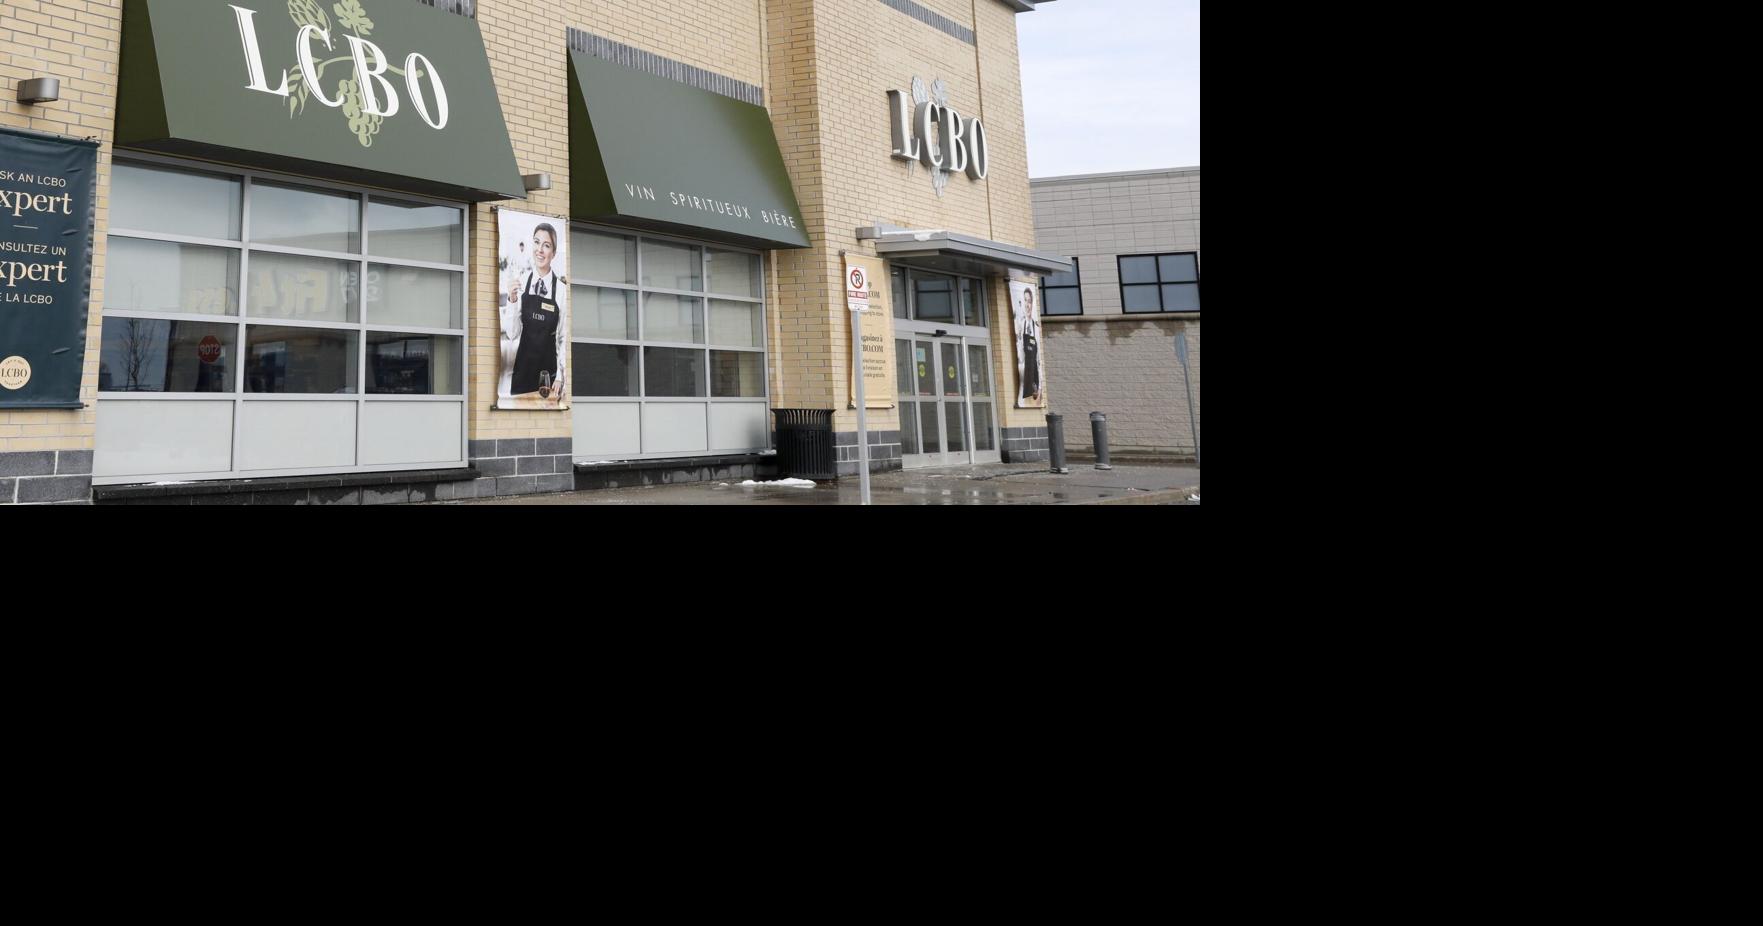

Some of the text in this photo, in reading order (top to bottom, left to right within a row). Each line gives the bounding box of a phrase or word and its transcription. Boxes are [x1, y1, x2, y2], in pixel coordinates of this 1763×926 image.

[228, 4, 449, 130] LCBO
[886, 89, 988, 181] LCBO
[0, 170, 67, 188] SK AN LCBO
[0, 189, 73, 217] xpert
[625, 183, 797, 229] VIN SPIRITUEUX BIÈRE
[0, 241, 67, 256] NSULTEZ UN
[0, 260, 67, 287] xpert
[6, 292, 20, 303] LA
[23, 294, 53, 305] LCBO
[1, 367, 28, 378] LCBO
